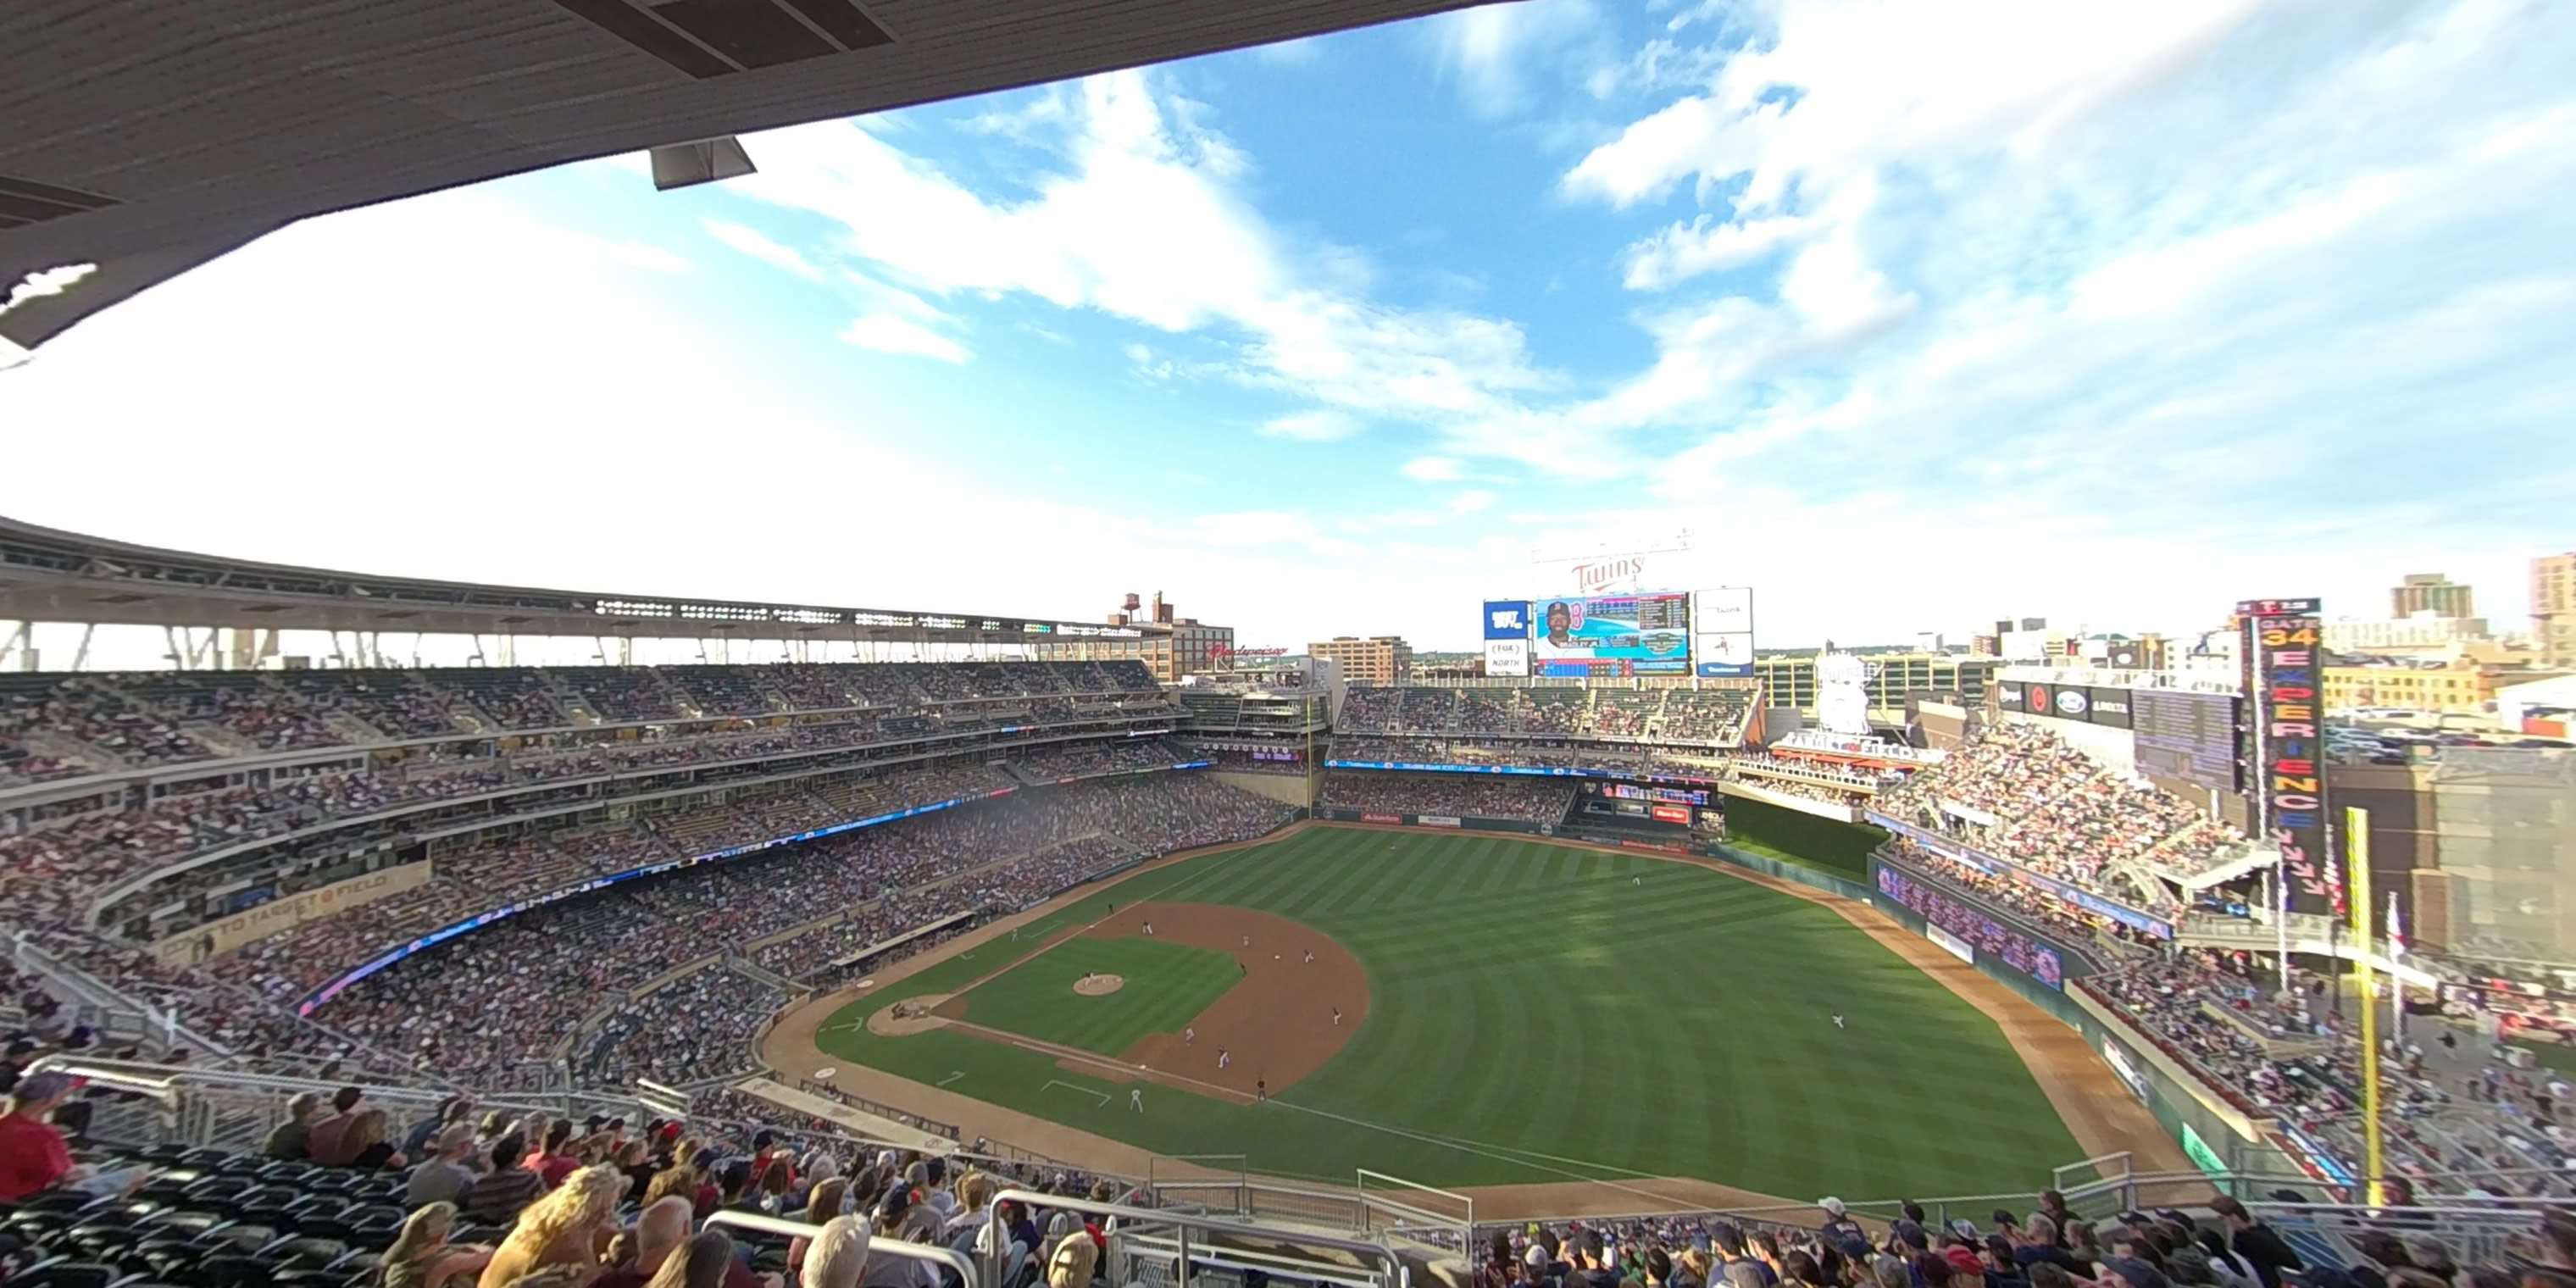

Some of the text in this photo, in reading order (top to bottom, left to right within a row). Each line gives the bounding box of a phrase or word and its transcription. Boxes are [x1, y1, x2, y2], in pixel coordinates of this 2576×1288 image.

[1571, 557, 1642, 590] Twins
[2261, 619, 2319, 629] GATE
[2263, 628, 2319, 647] 34
[2271, 651, 2319, 828] EXPERIENCE
[249, 893, 318, 926] TARGET
[336, 875, 388, 897] FIELD
